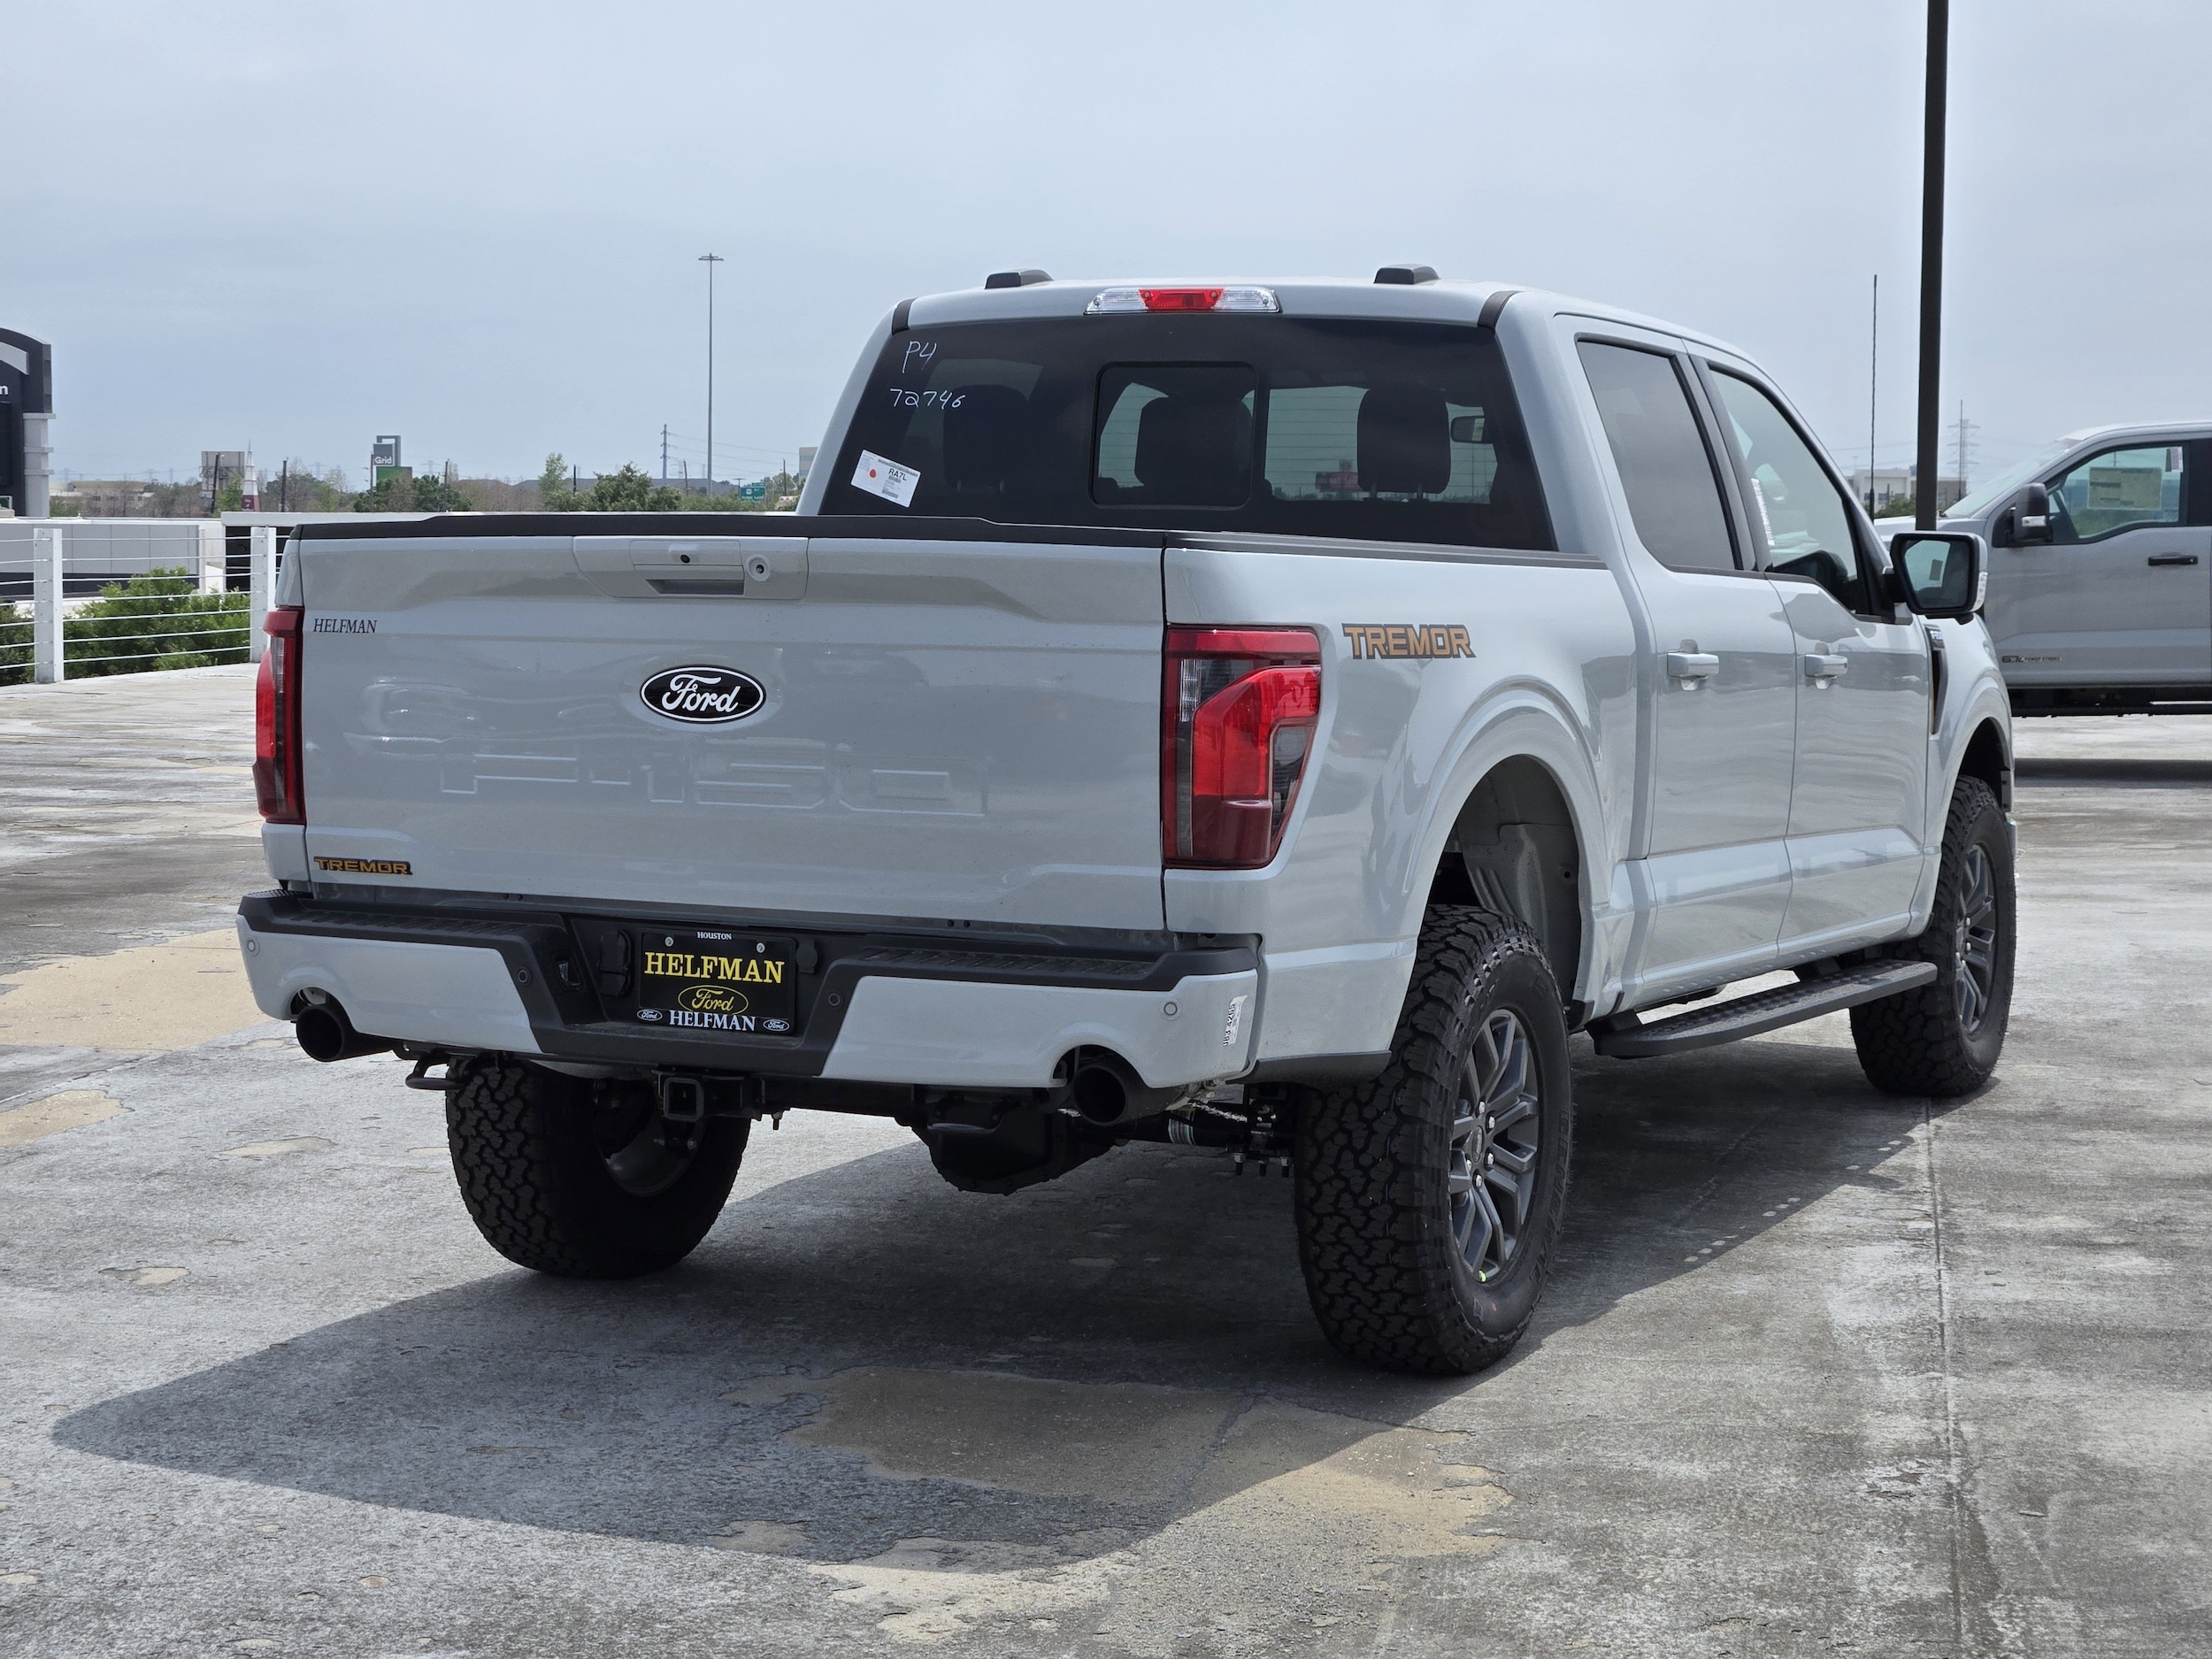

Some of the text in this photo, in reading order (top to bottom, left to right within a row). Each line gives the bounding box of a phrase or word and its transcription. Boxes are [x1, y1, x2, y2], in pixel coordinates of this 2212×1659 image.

[890, 388, 965, 410] 72746
[374, 456, 393, 465] Grid
[888, 468, 907, 481] RA7L
[312, 618, 378, 634] HELFMAN
[1341, 623, 1477, 660] TREMOR
[661, 673, 741, 713] Ford
[314, 856, 413, 876] TREMOR
[696, 932, 733, 941] HOUSTON
[644, 951, 786, 984] HELFMAN
[691, 988, 734, 1012] Ford
[669, 1010, 756, 1032] HELFMAN
